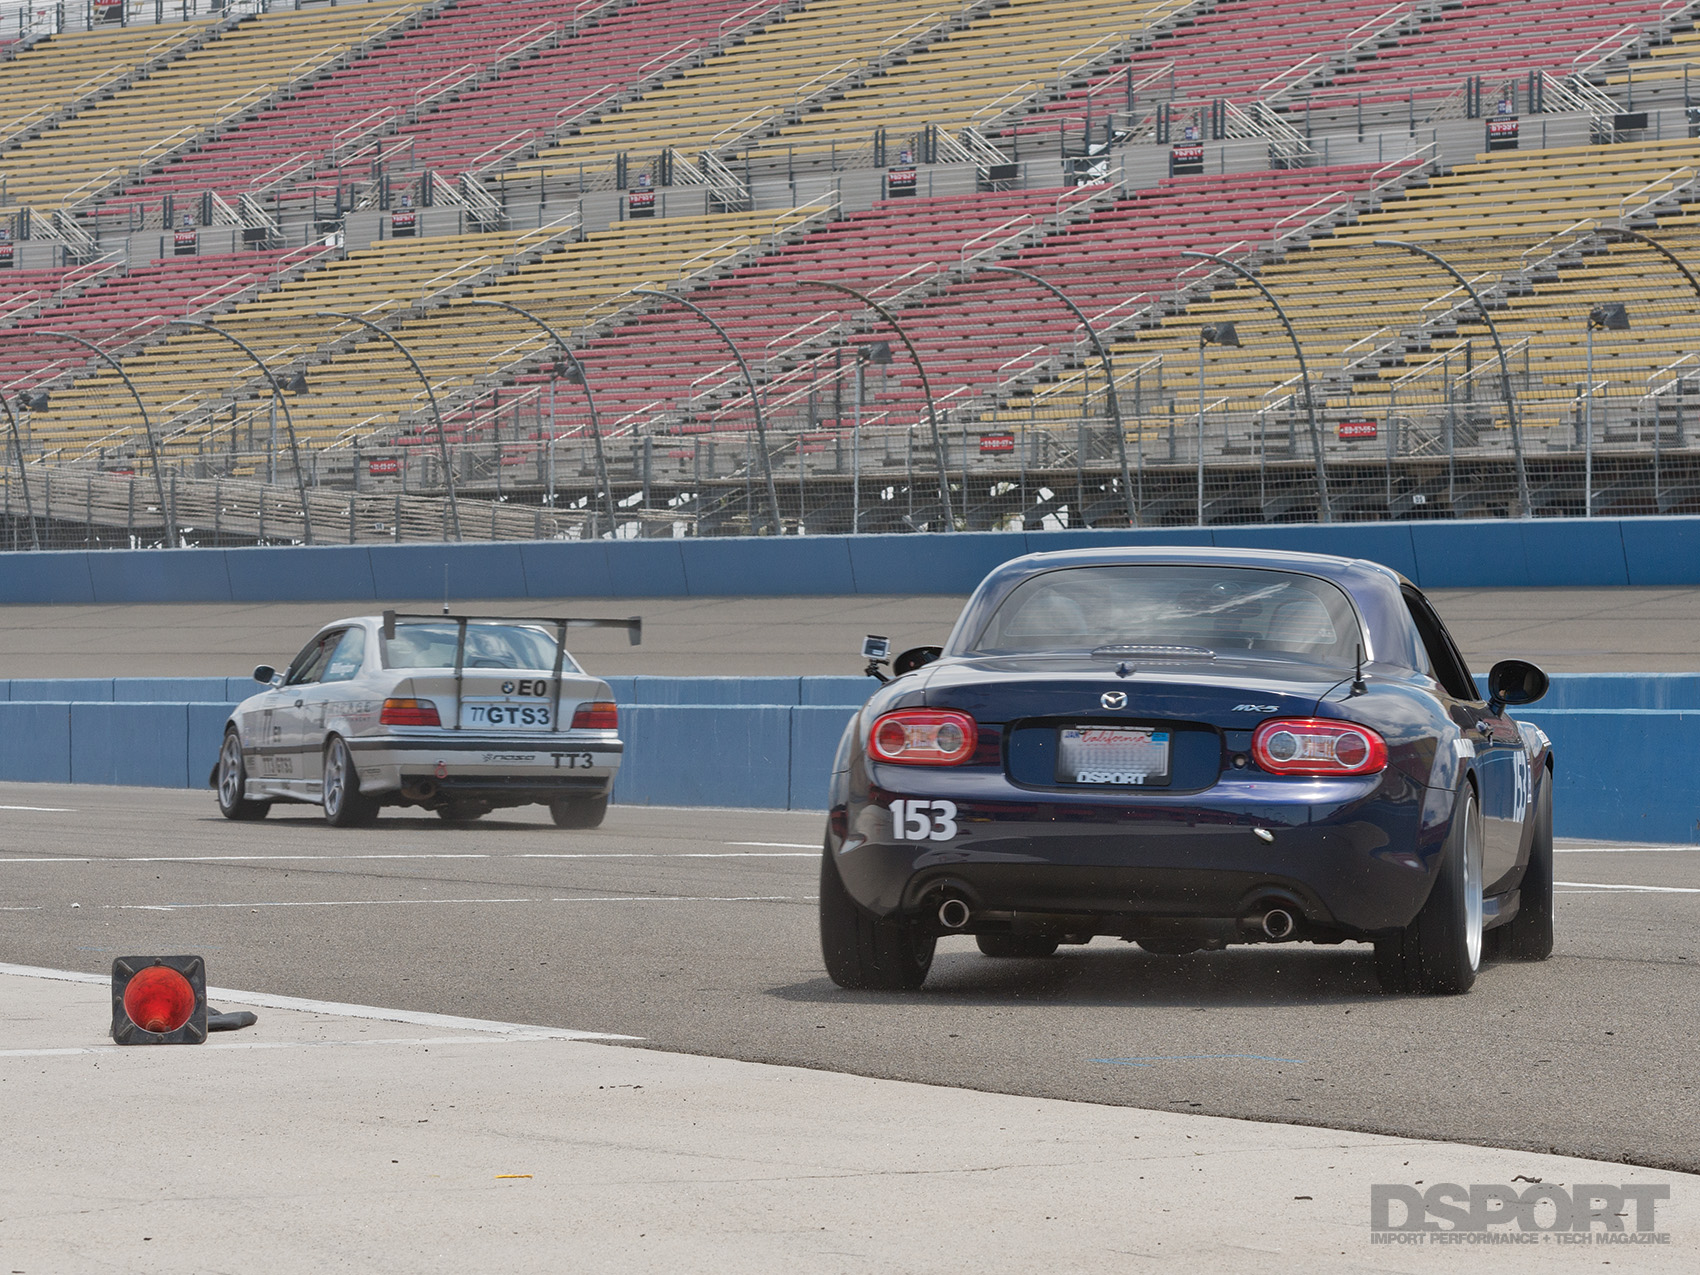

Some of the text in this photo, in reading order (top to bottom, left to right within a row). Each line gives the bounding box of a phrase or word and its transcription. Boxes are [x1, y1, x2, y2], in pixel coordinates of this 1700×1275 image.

[518, 680, 546, 697] E0
[1231, 704, 1280, 713] MX-5
[1081, 729, 1152, 744] California
[551, 753, 593, 770] TT3
[1076, 771, 1148, 785] DSPORT
[888, 799, 958, 842] 153
